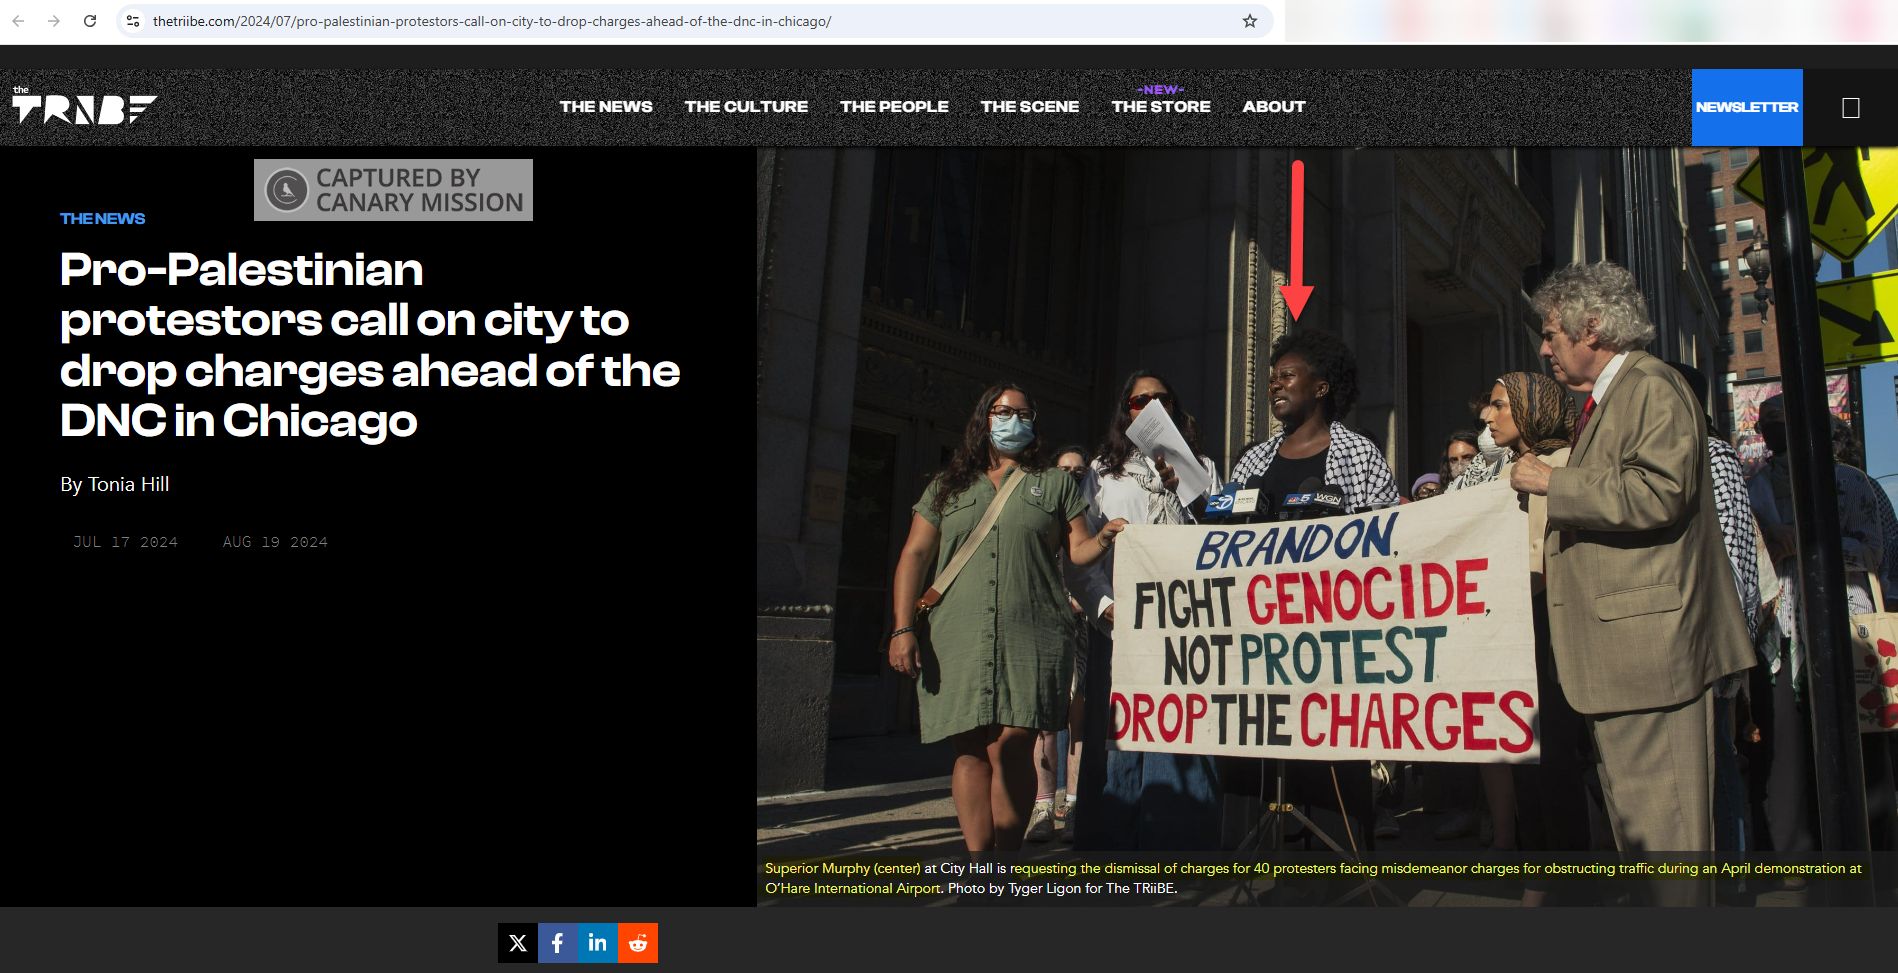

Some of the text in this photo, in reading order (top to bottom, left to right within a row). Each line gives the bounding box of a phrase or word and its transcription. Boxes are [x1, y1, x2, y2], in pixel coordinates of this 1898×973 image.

[153, 14, 832, 30] thetriibe.com/2024/07/pro-palestinian-protestors-call-on-city-to-drop-charges-ahead-of-the-dnc-in-chicago/
[12, 84, 30, 94] the
[559, 100, 653, 113] THE NEWS
[684, 100, 809, 113] THE CULTURE
[839, 100, 949, 113] THE PEOPLE
[980, 100, 1080, 113] THE SCENE
[1111, 100, 1211, 113] THE STORE
[1242, 100, 1307, 113] ABOUT
[1696, 101, 1799, 113] NEWSLETTER
[60, 212, 146, 225] THE NEWS
[61, 251, 423, 287] Pro-Palestinian
[61, 301, 630, 345] protestors call on city to
[60, 352, 681, 396] drop charges ahead of the
[61, 402, 418, 446] DNC in Chicago
[61, 475, 169, 497] By Tonia Hill
[1316, 493, 1341, 504] WGN
[73, 535, 178, 549] JUL 17 2024
[222, 535, 328, 549] AUG 19 2024
[1196, 511, 1400, 570] BRANDON,
[1133, 557, 1491, 630] FIGHT GENOCIDE,
[1164, 625, 1448, 686] NOT PROTEST
[1110, 690, 1535, 753] DROP THE CHARGES
[765, 862, 1863, 878] Superior Murphy (center) at City Hall is requesting the dismissal of charges for 40 protesters facing misdemeanor charges for obstructing traffic during an April demonstration at
[814, 882, 893, 894] International
[895, 882, 945, 898] Airport.
[948, 882, 986, 894] Photo
[989, 882, 1005, 898] by
[1007, 882, 1044, 898] Tyger
[1046, 882, 1082, 898] Ligon
[1084, 882, 1104, 894] for
[1105, 882, 1131, 894] The
[1132, 882, 1179, 894] TRiiBE.
